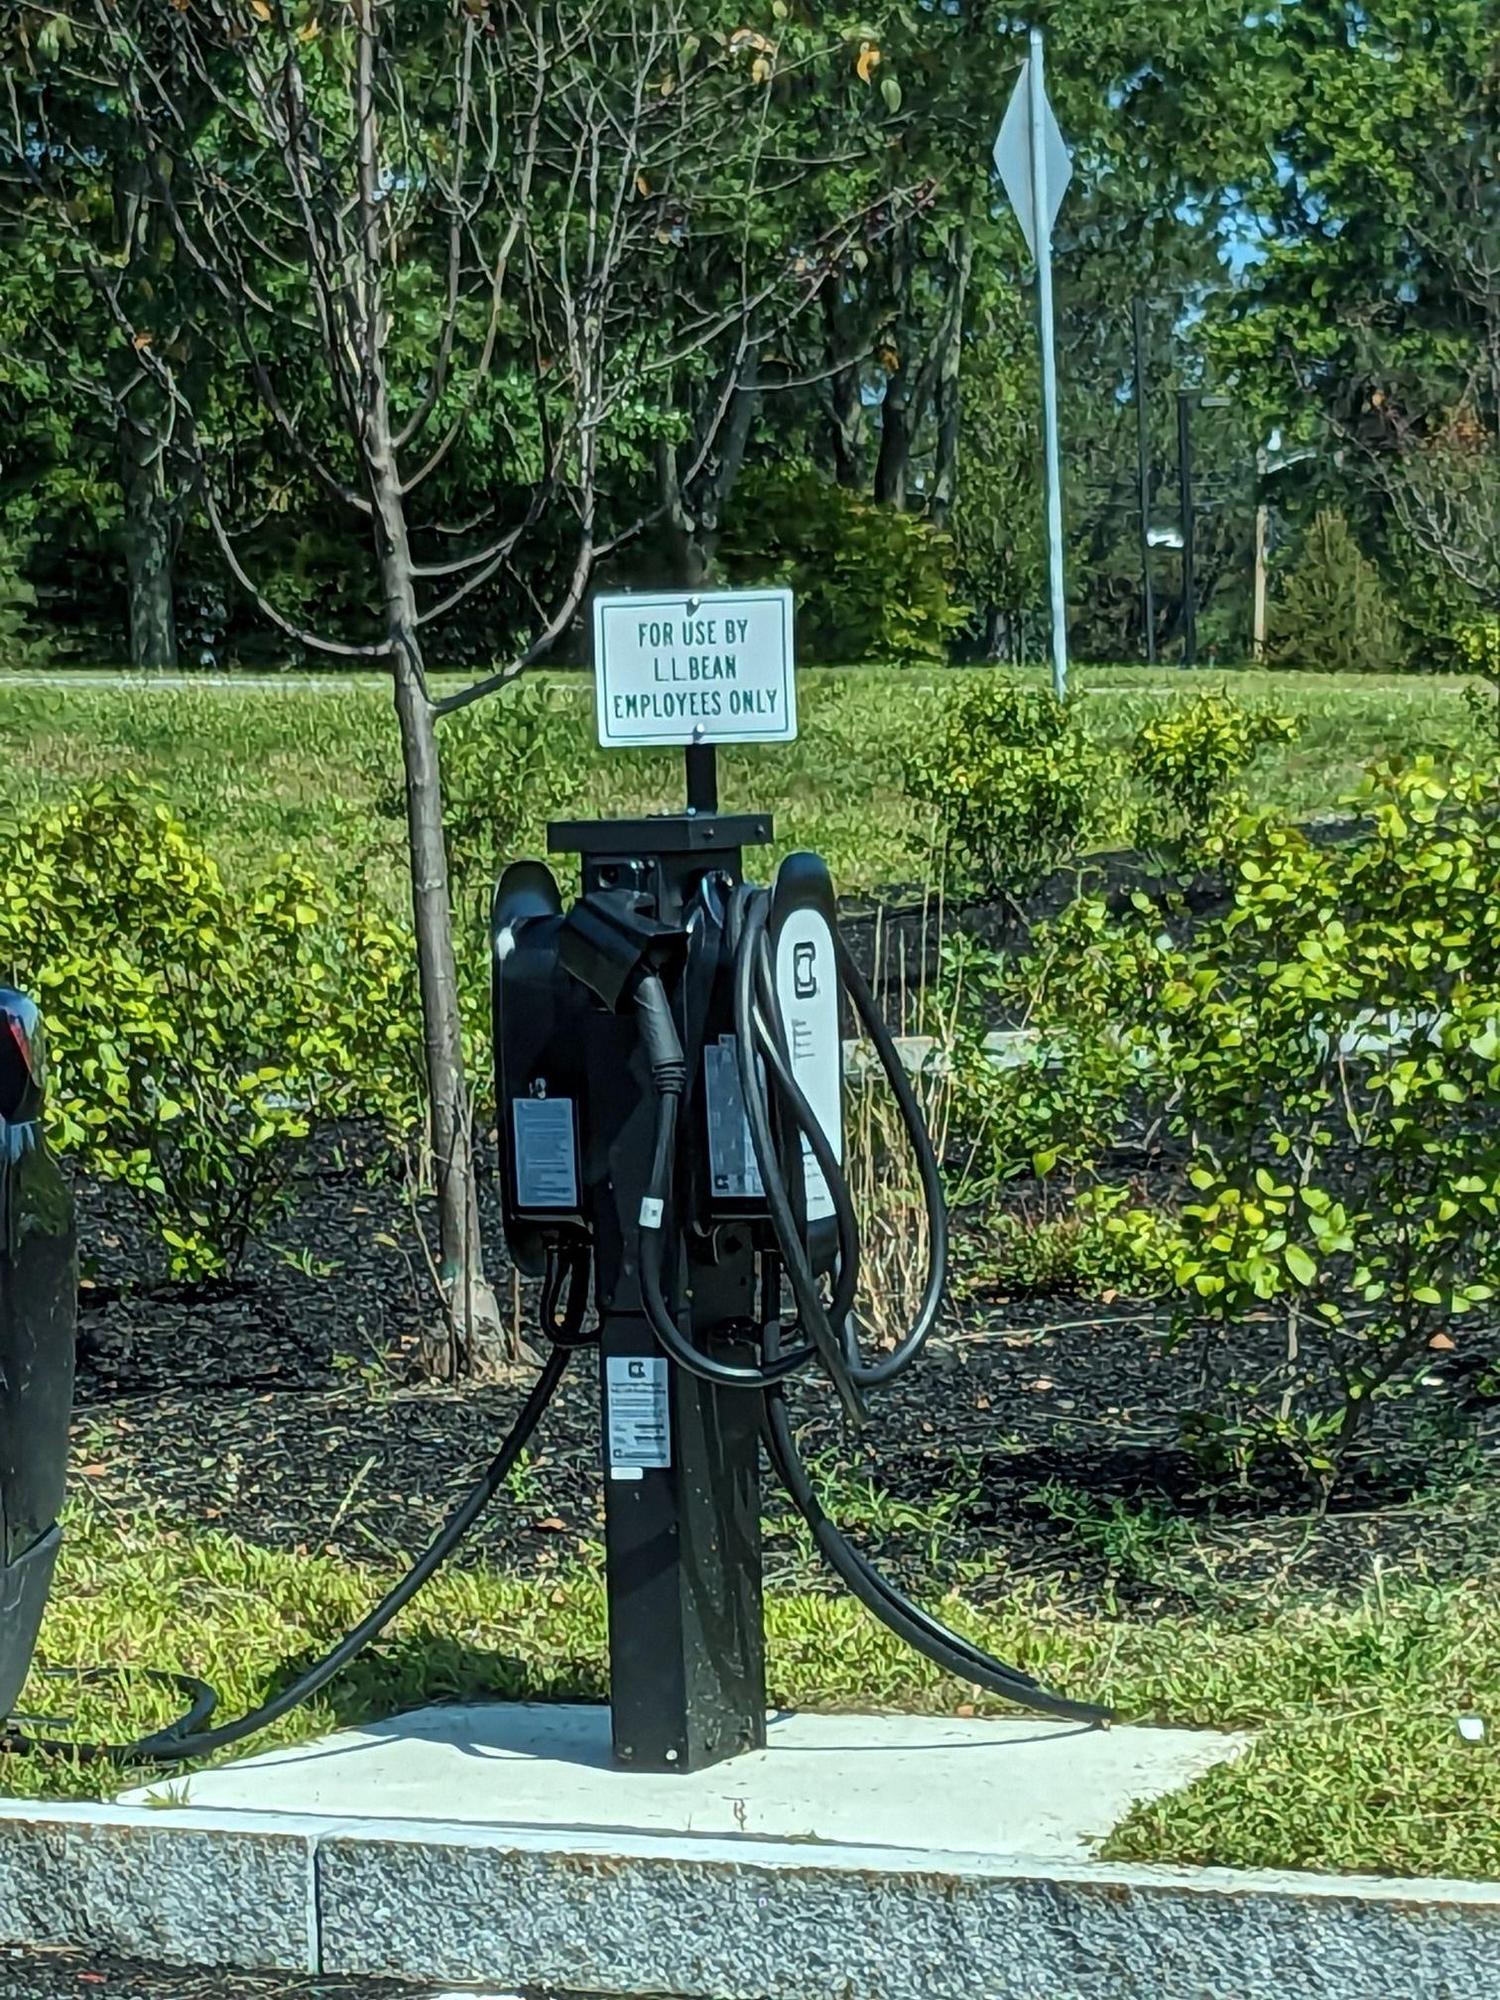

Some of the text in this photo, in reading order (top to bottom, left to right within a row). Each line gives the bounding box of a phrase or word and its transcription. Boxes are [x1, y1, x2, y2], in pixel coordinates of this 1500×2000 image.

[638, 619, 748, 647] FOR USE BY
[613, 688, 777, 719] EMPLOYEES ONLY
